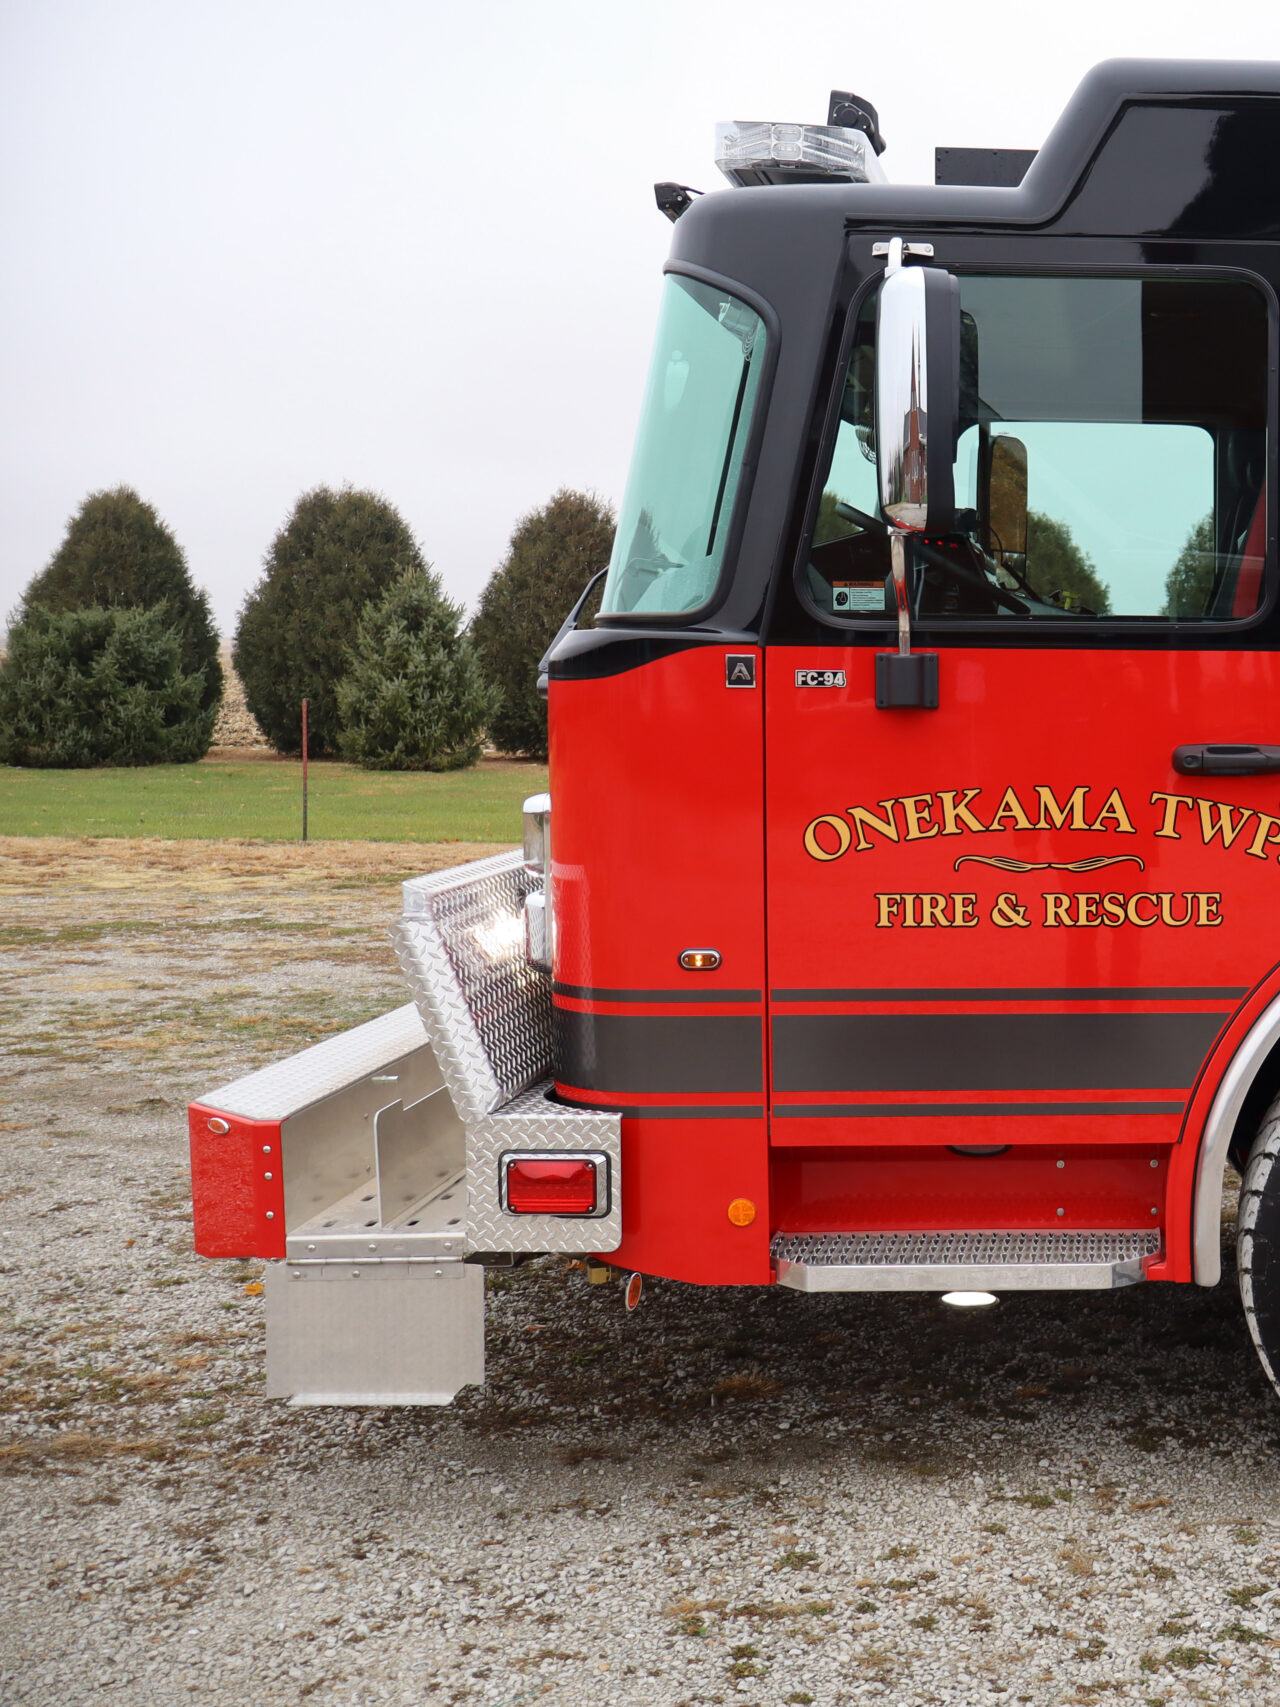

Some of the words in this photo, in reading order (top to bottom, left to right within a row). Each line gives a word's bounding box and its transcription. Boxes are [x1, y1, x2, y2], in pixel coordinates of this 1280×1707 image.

[797, 672, 845, 686] FC-94
[802, 785, 1137, 862] ONEKAMA
[874, 893, 979, 928] FIRE
[990, 892, 1031, 928] &
[1042, 892, 1223, 928] RESCUE
